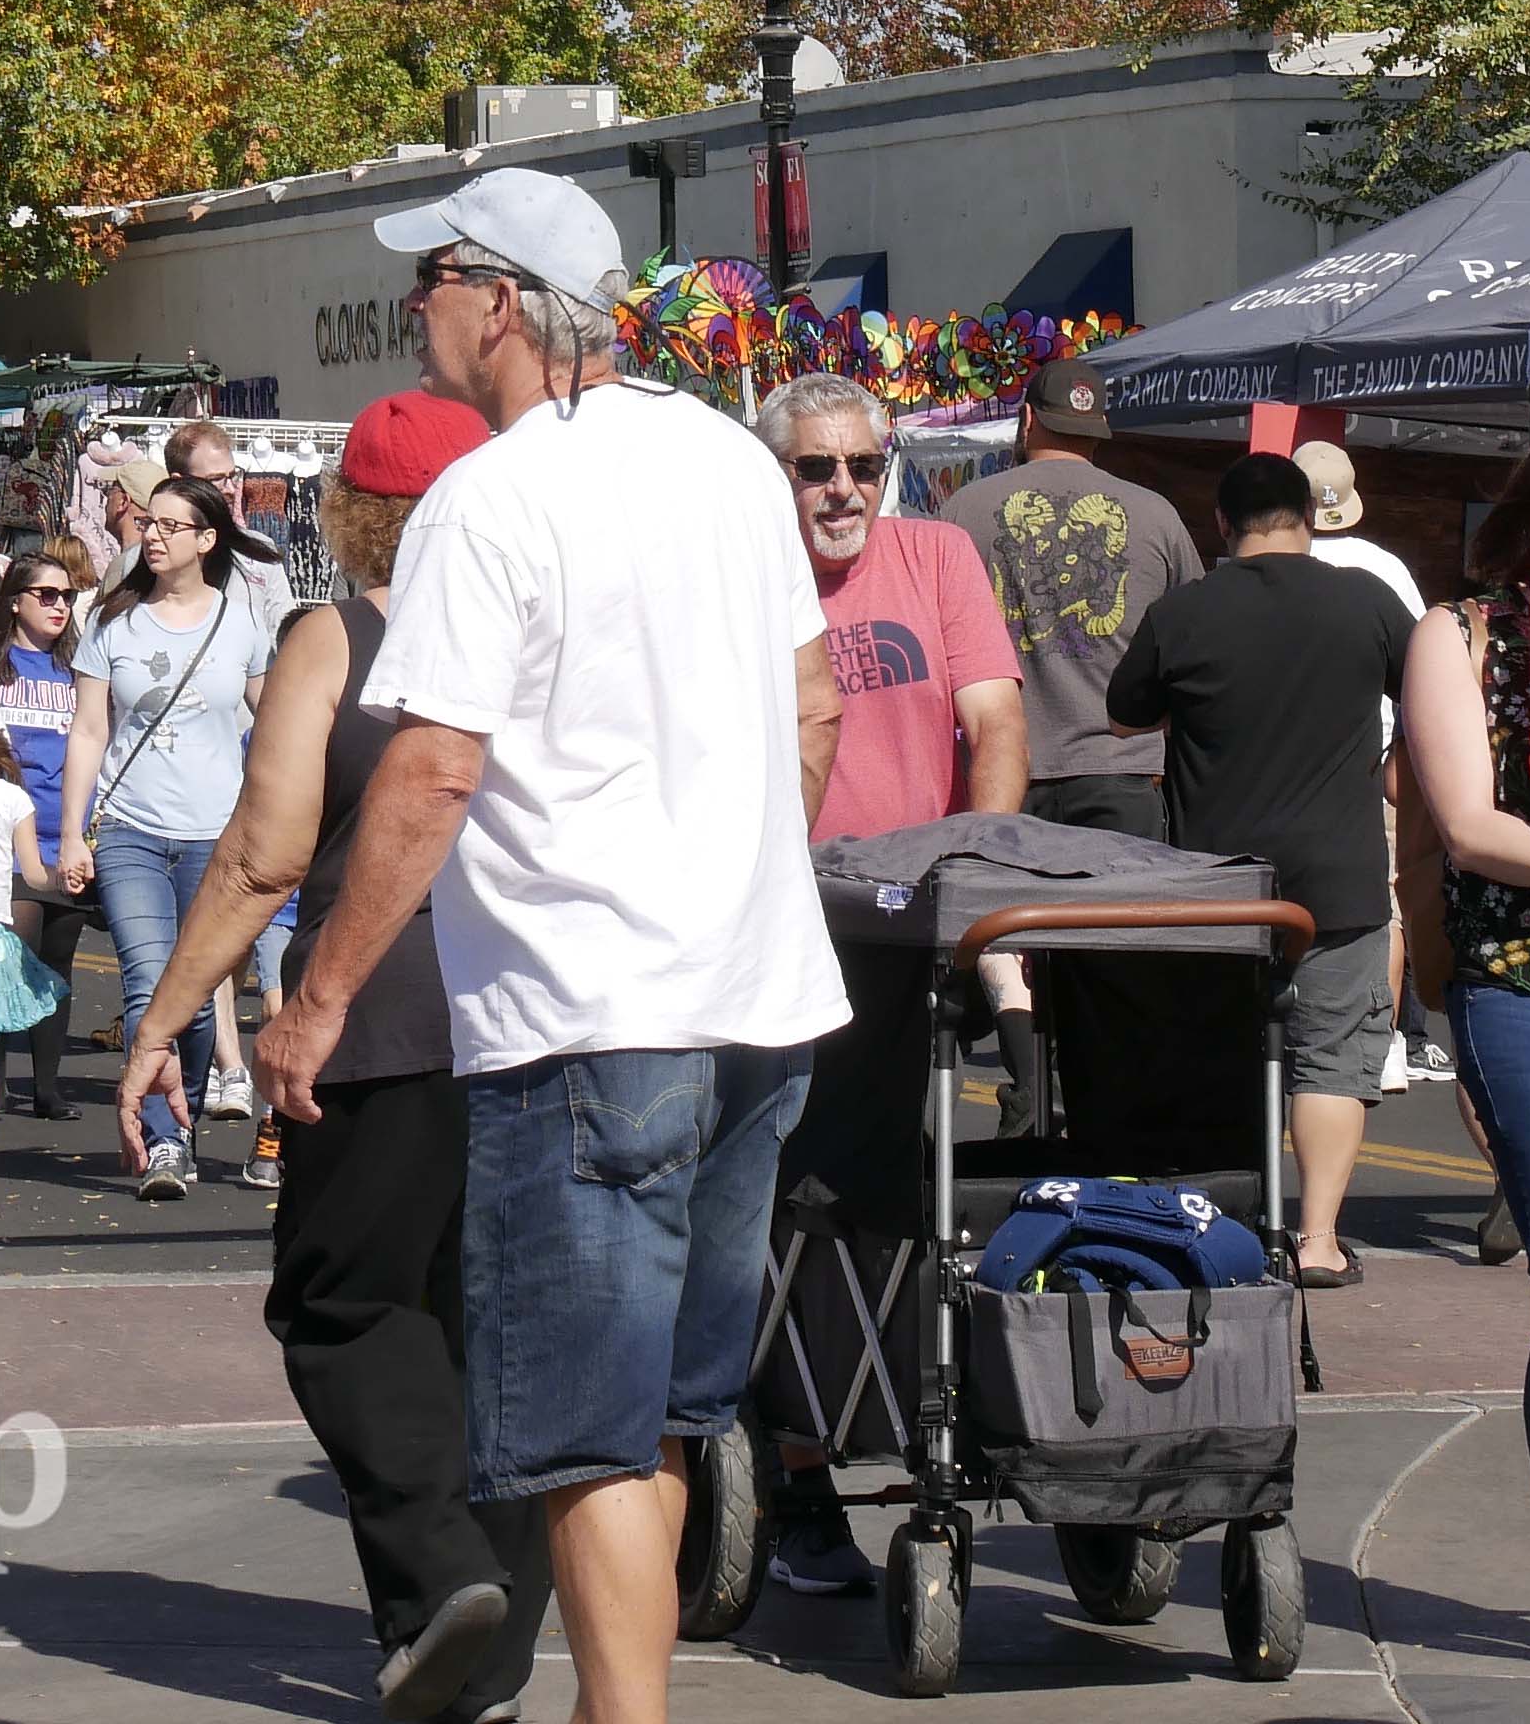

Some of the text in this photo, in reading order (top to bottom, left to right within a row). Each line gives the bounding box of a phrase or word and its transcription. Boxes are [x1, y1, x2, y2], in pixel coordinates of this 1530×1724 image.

[1296, 251, 1418, 280] REALTY
[1229, 282, 1379, 312] CONCEPTS
[315, 299, 382, 367] CLOVIS
[1119, 367, 1183, 409] FAMILY
[1187, 364, 1278, 403] COMPANY
[1313, 344, 1527, 401] THE FAMILY COMPANY
[826, 619, 871, 651] THE
[829, 643, 876, 673] RTH
[835, 667, 881, 696] ACE
